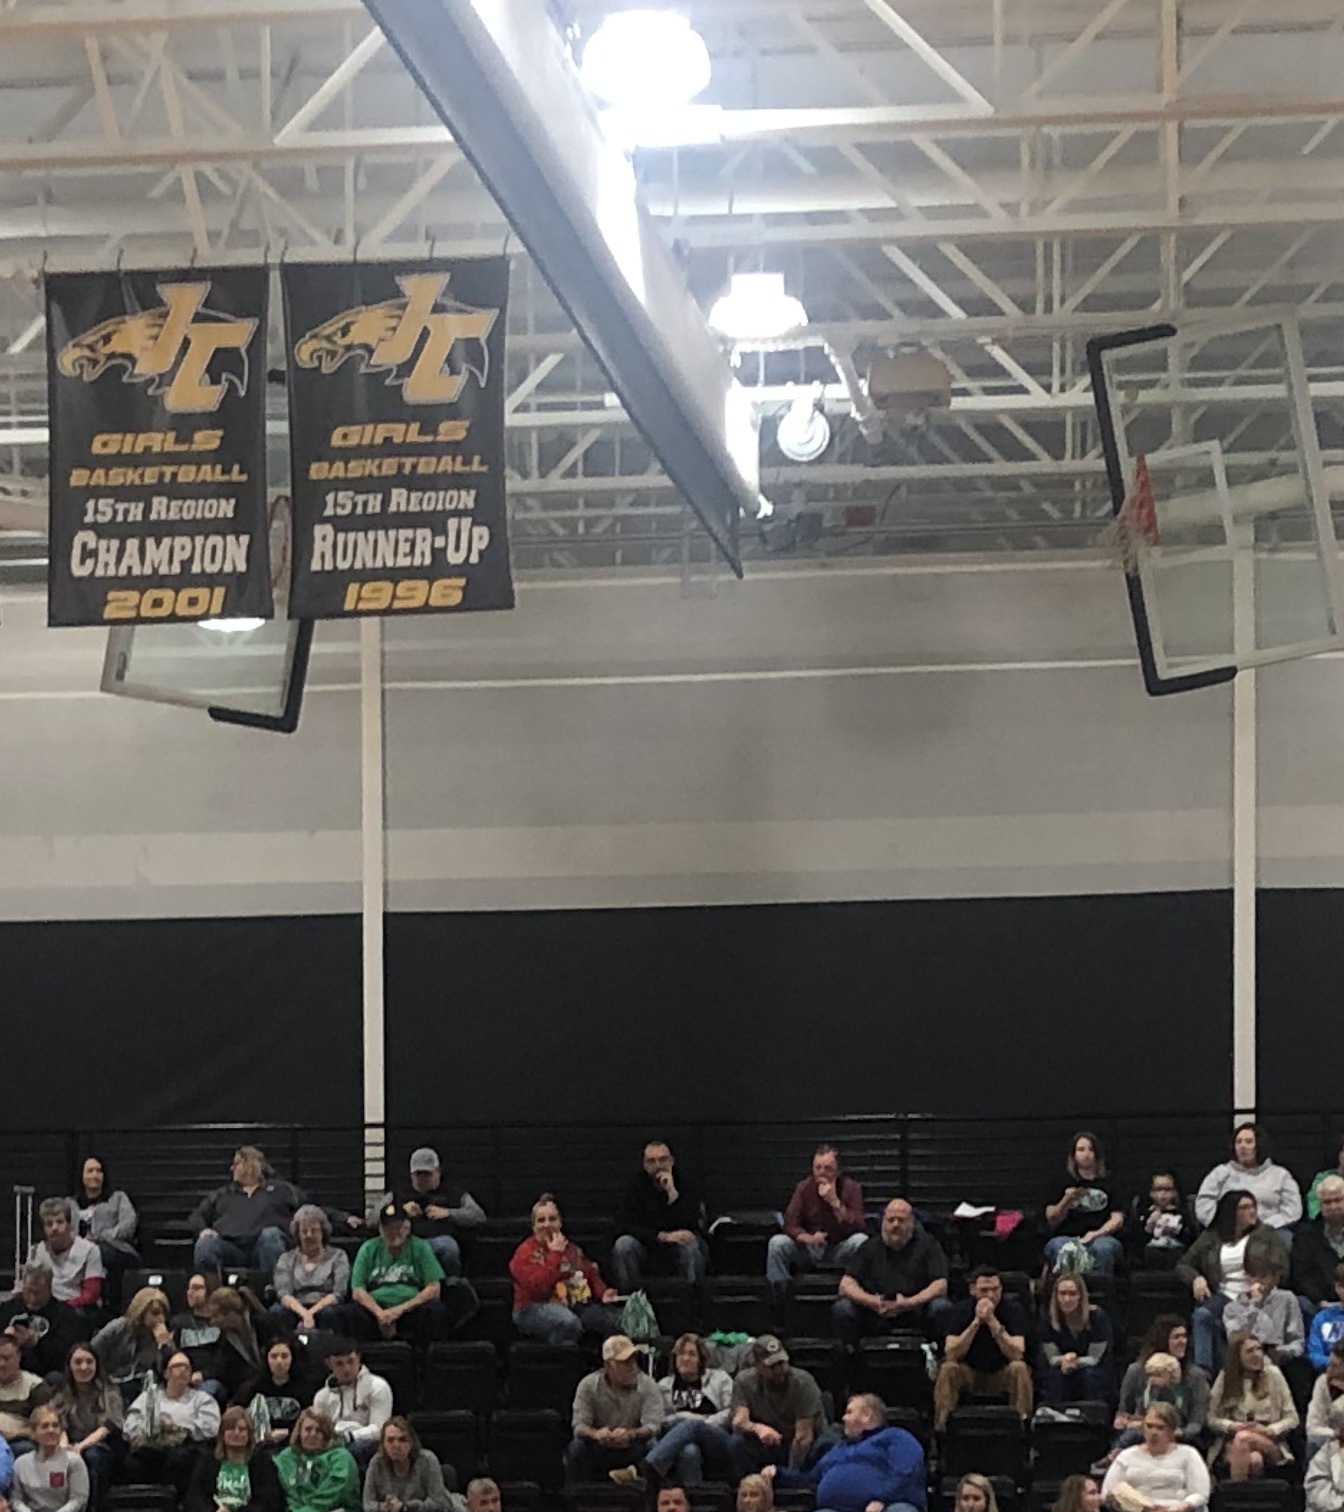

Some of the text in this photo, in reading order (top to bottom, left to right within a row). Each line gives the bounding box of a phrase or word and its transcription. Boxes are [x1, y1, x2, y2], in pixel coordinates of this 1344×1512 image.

[91, 428, 224, 454] GIRLS
[330, 420, 470, 447] GIRLS
[69, 463, 249, 488] BASKETBALL
[309, 454, 489, 480] BASKETBALL
[83, 496, 236, 523] 15TH REGION
[323, 487, 477, 516] 15TH REGION
[70, 529, 250, 577] CHAMPION
[310, 516, 490, 572] RUNNER-UP
[103, 586, 226, 619] 2001
[343, 576, 467, 611] 1996
